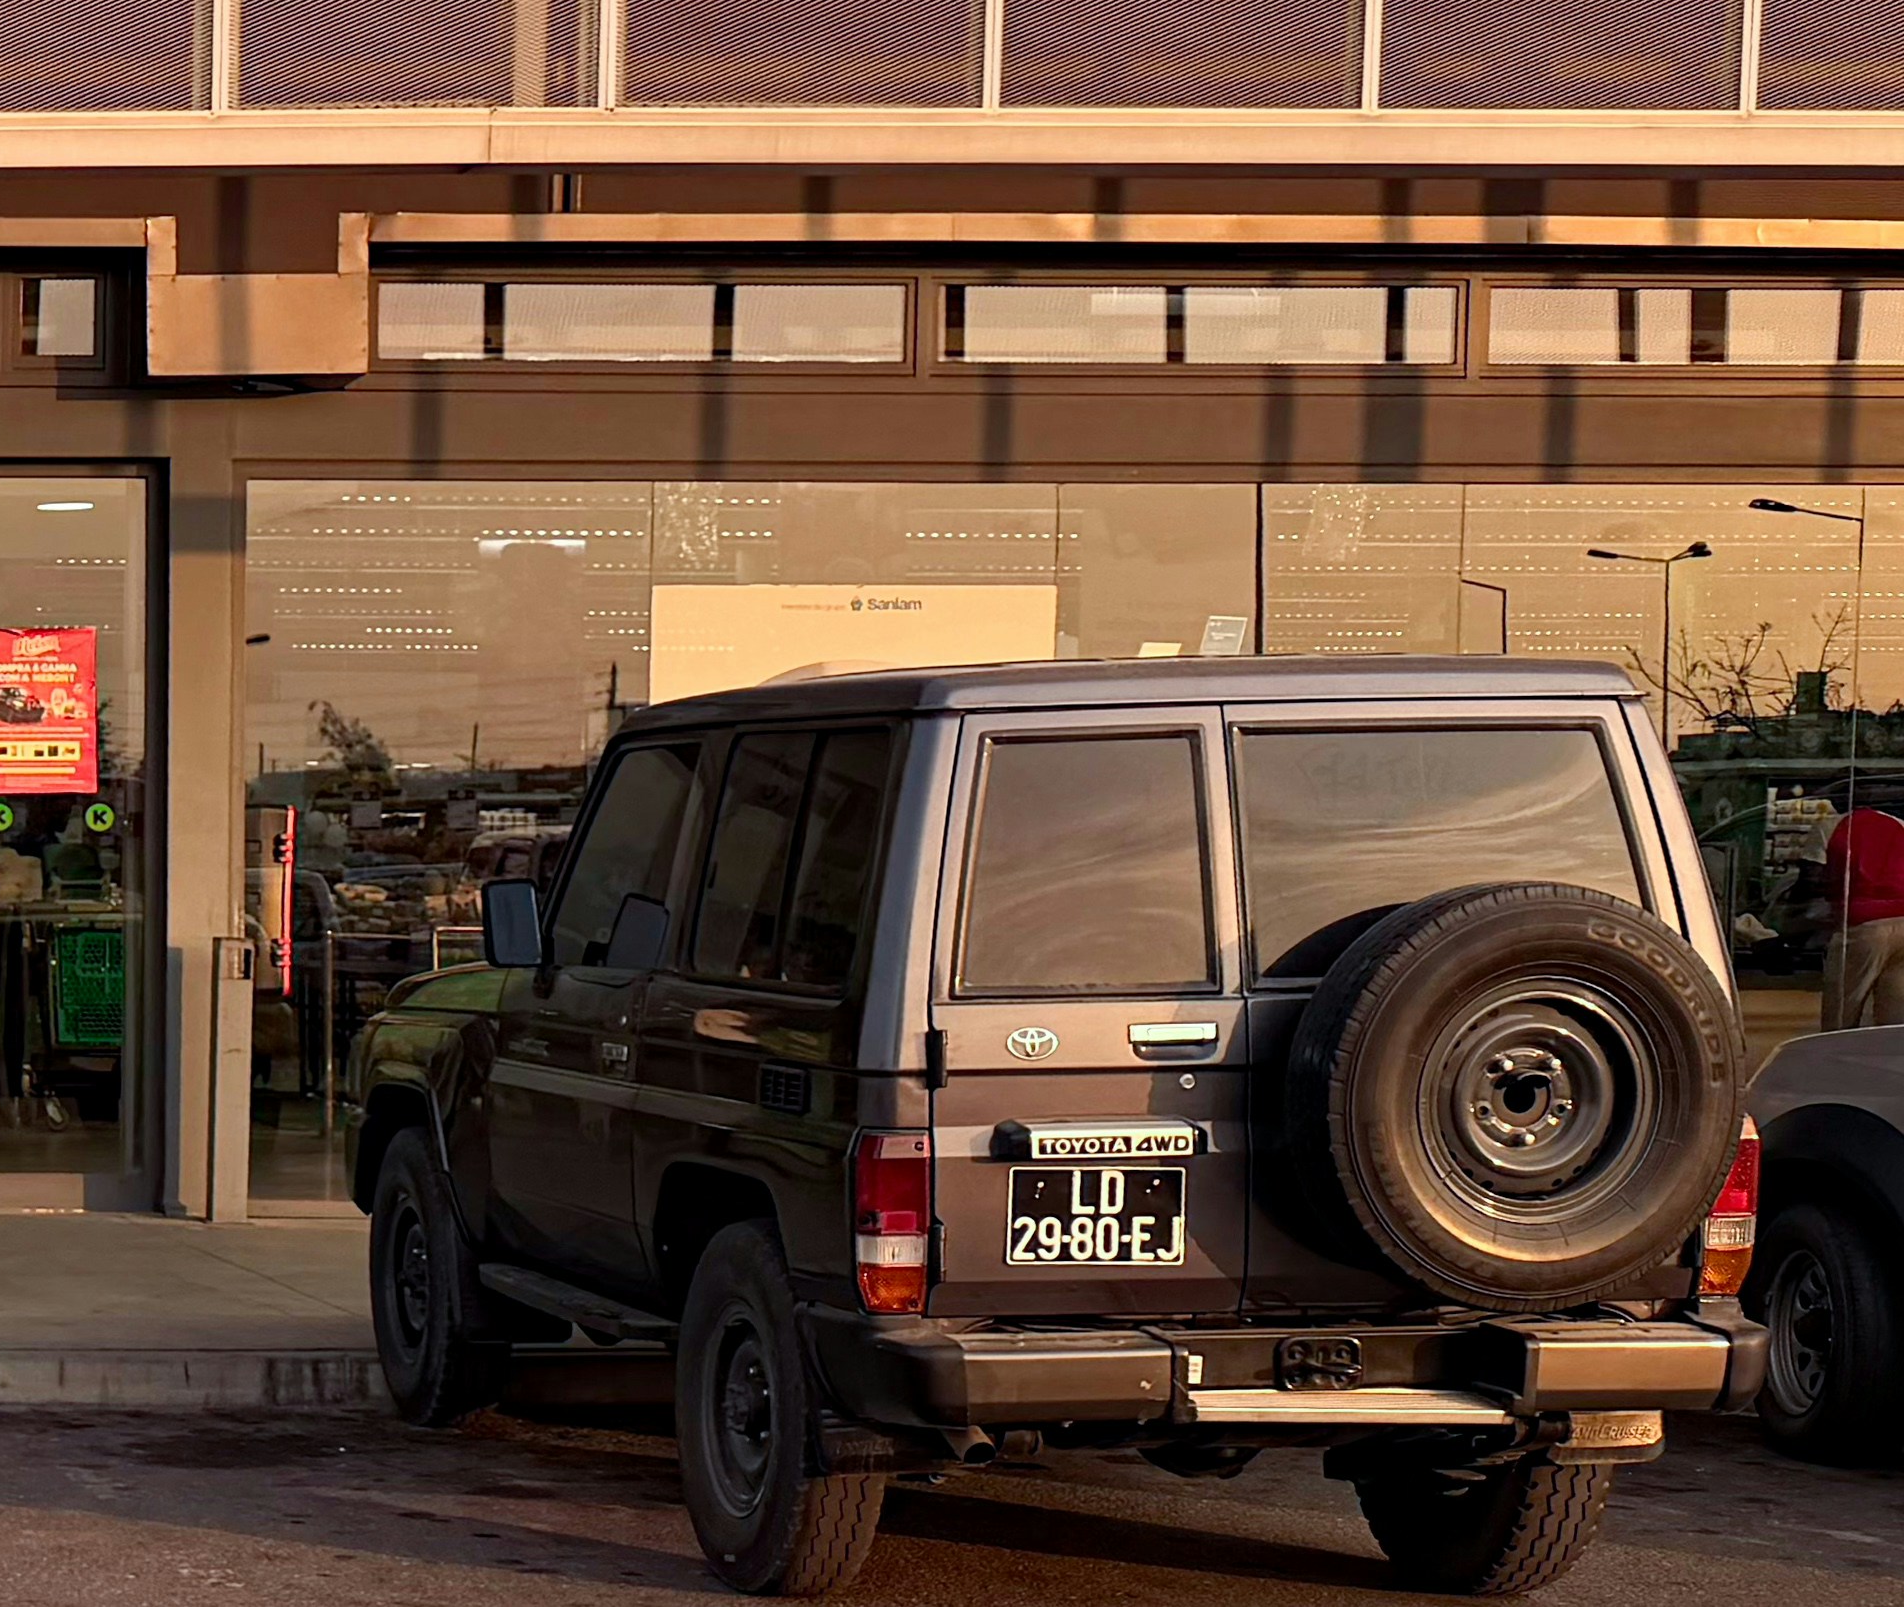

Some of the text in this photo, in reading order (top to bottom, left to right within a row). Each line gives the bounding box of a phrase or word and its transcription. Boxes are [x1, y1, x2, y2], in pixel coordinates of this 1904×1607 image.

[867, 597, 922, 610] Sanlam
[1587, 919, 1725, 1088] GOODRIDE
[1042, 1136, 1190, 1154] TOYOTA 4WD
[1071, 1170, 1125, 1215] LD
[1012, 1216, 1181, 1261] 29-80-EJ
